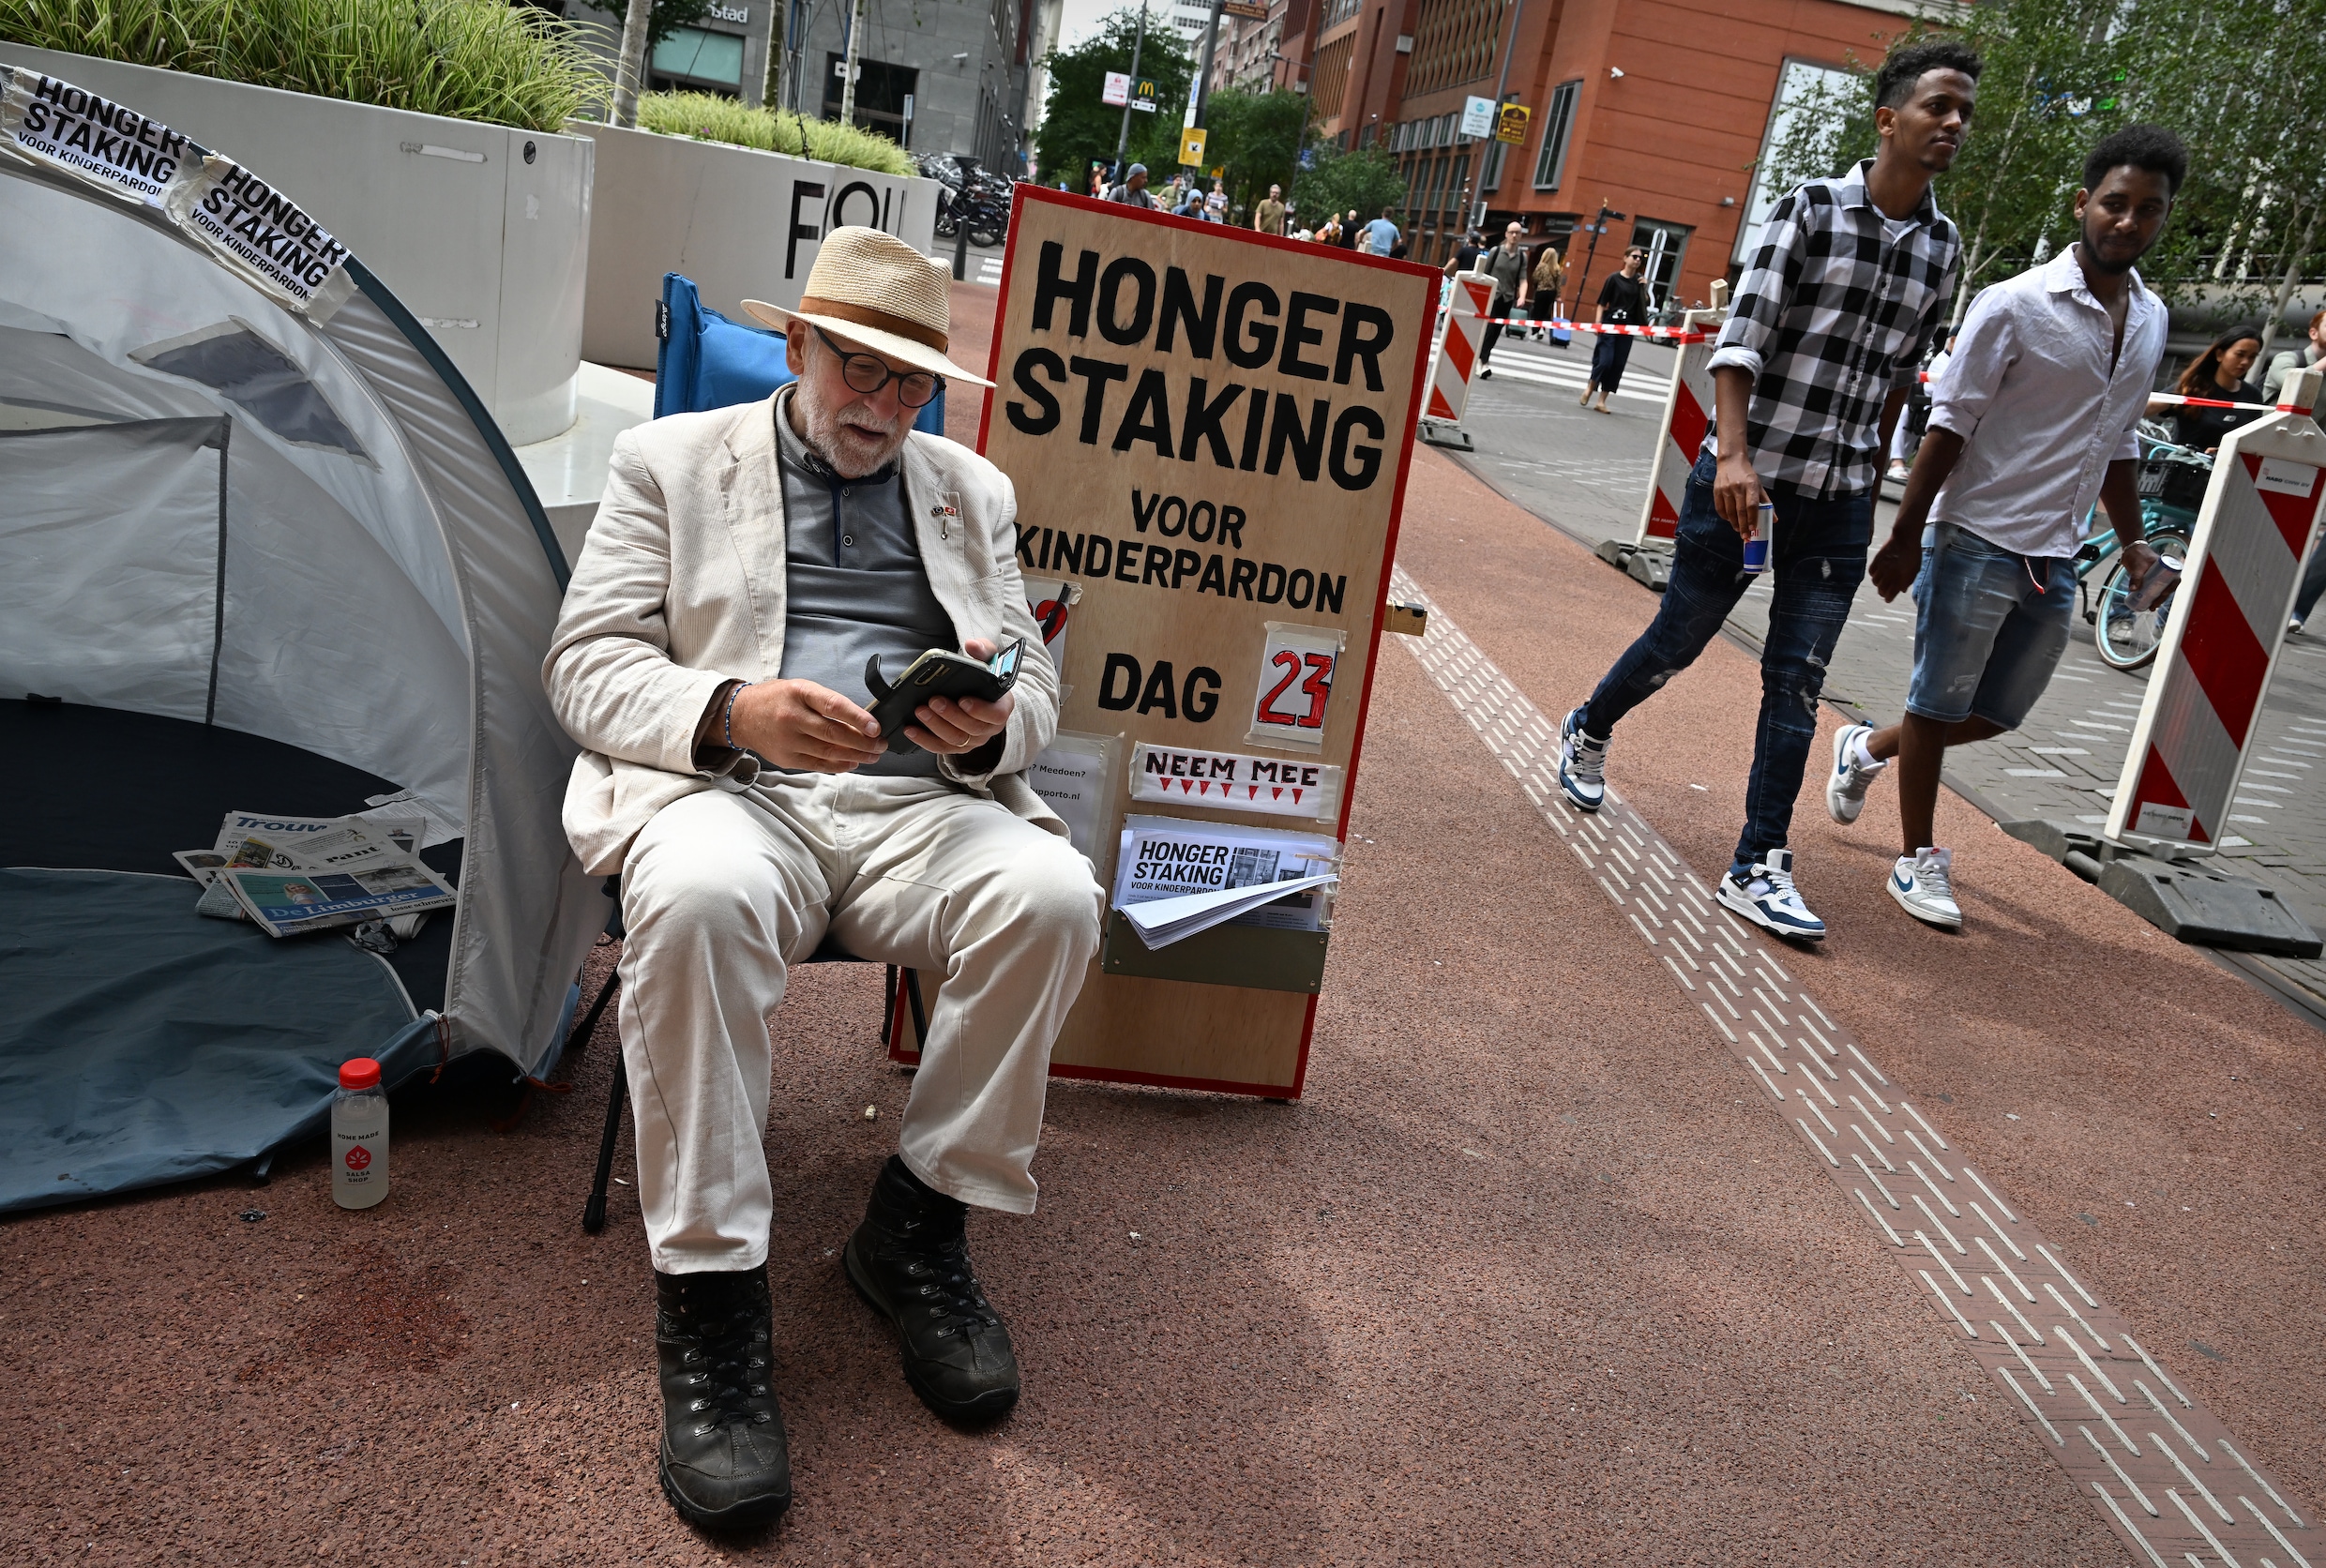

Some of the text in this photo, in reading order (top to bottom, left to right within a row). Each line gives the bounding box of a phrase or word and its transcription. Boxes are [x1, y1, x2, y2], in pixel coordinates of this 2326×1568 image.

[19, 132, 57, 156] VOOR
[24, 103, 176, 183] STAKING
[35, 76, 186, 158] HONGER
[203, 188, 328, 287] STAKING
[220, 165, 347, 265] HONGER
[191, 208, 311, 301] VOOR KINDERPARDON
[1032, 241, 1394, 392] HONGER
[1006, 347, 1385, 490] STAKING
[1131, 489, 1246, 549] VOOR
[1014, 522, 1347, 614] KINDERPARDON
[1098, 650, 1334, 729] DAG 23
[1039, 764, 1086, 778] Meedoen?
[1145, 753, 1320, 787] NEEM MEE
[1131, 882, 1153, 890] VOOR
[1134, 862, 1223, 884] STAKING
[1139, 840, 1229, 865] HONGER
[269, 892, 419, 917] De Limburger
[358, 1131, 379, 1140] MADE
